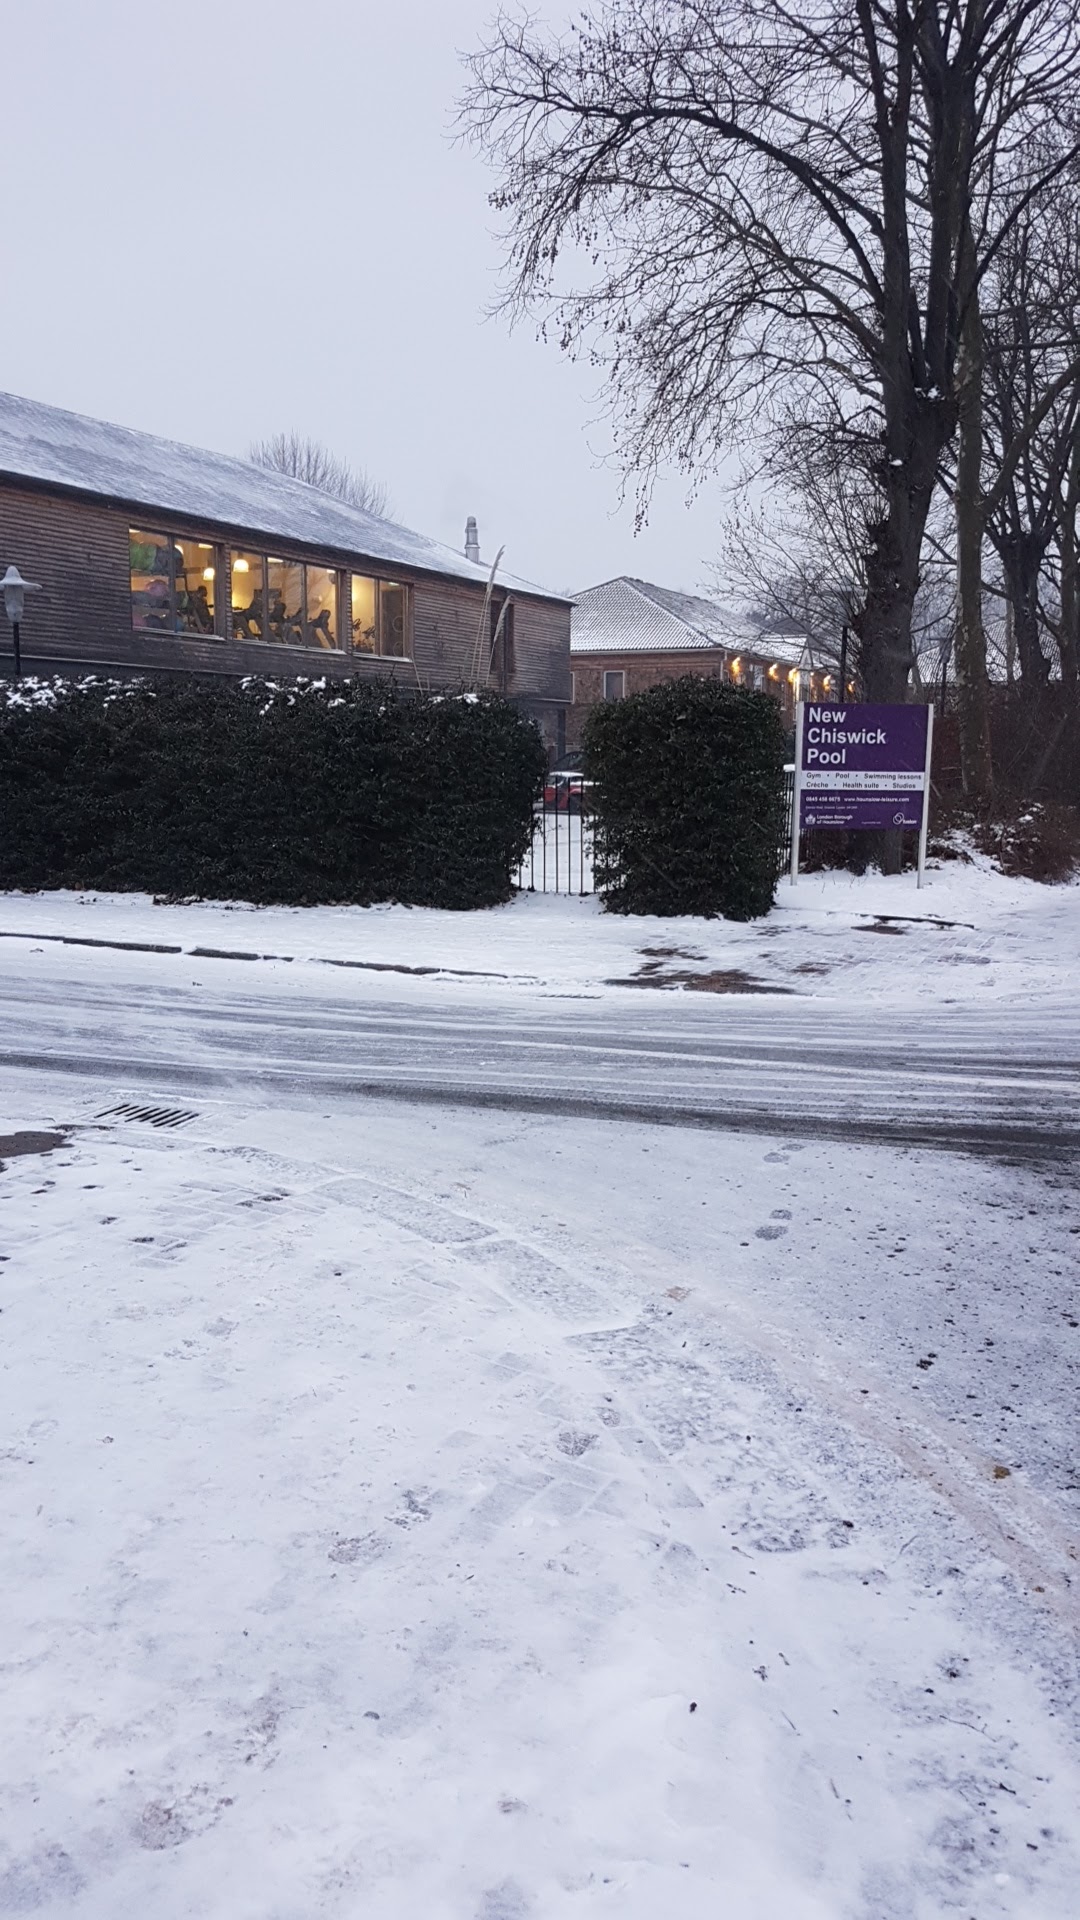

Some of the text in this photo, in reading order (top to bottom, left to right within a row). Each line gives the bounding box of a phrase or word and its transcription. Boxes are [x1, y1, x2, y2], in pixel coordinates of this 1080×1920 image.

[808, 707, 846, 723] New
[807, 727, 886, 744] Chiswick
[806, 748, 846, 764] Pool
